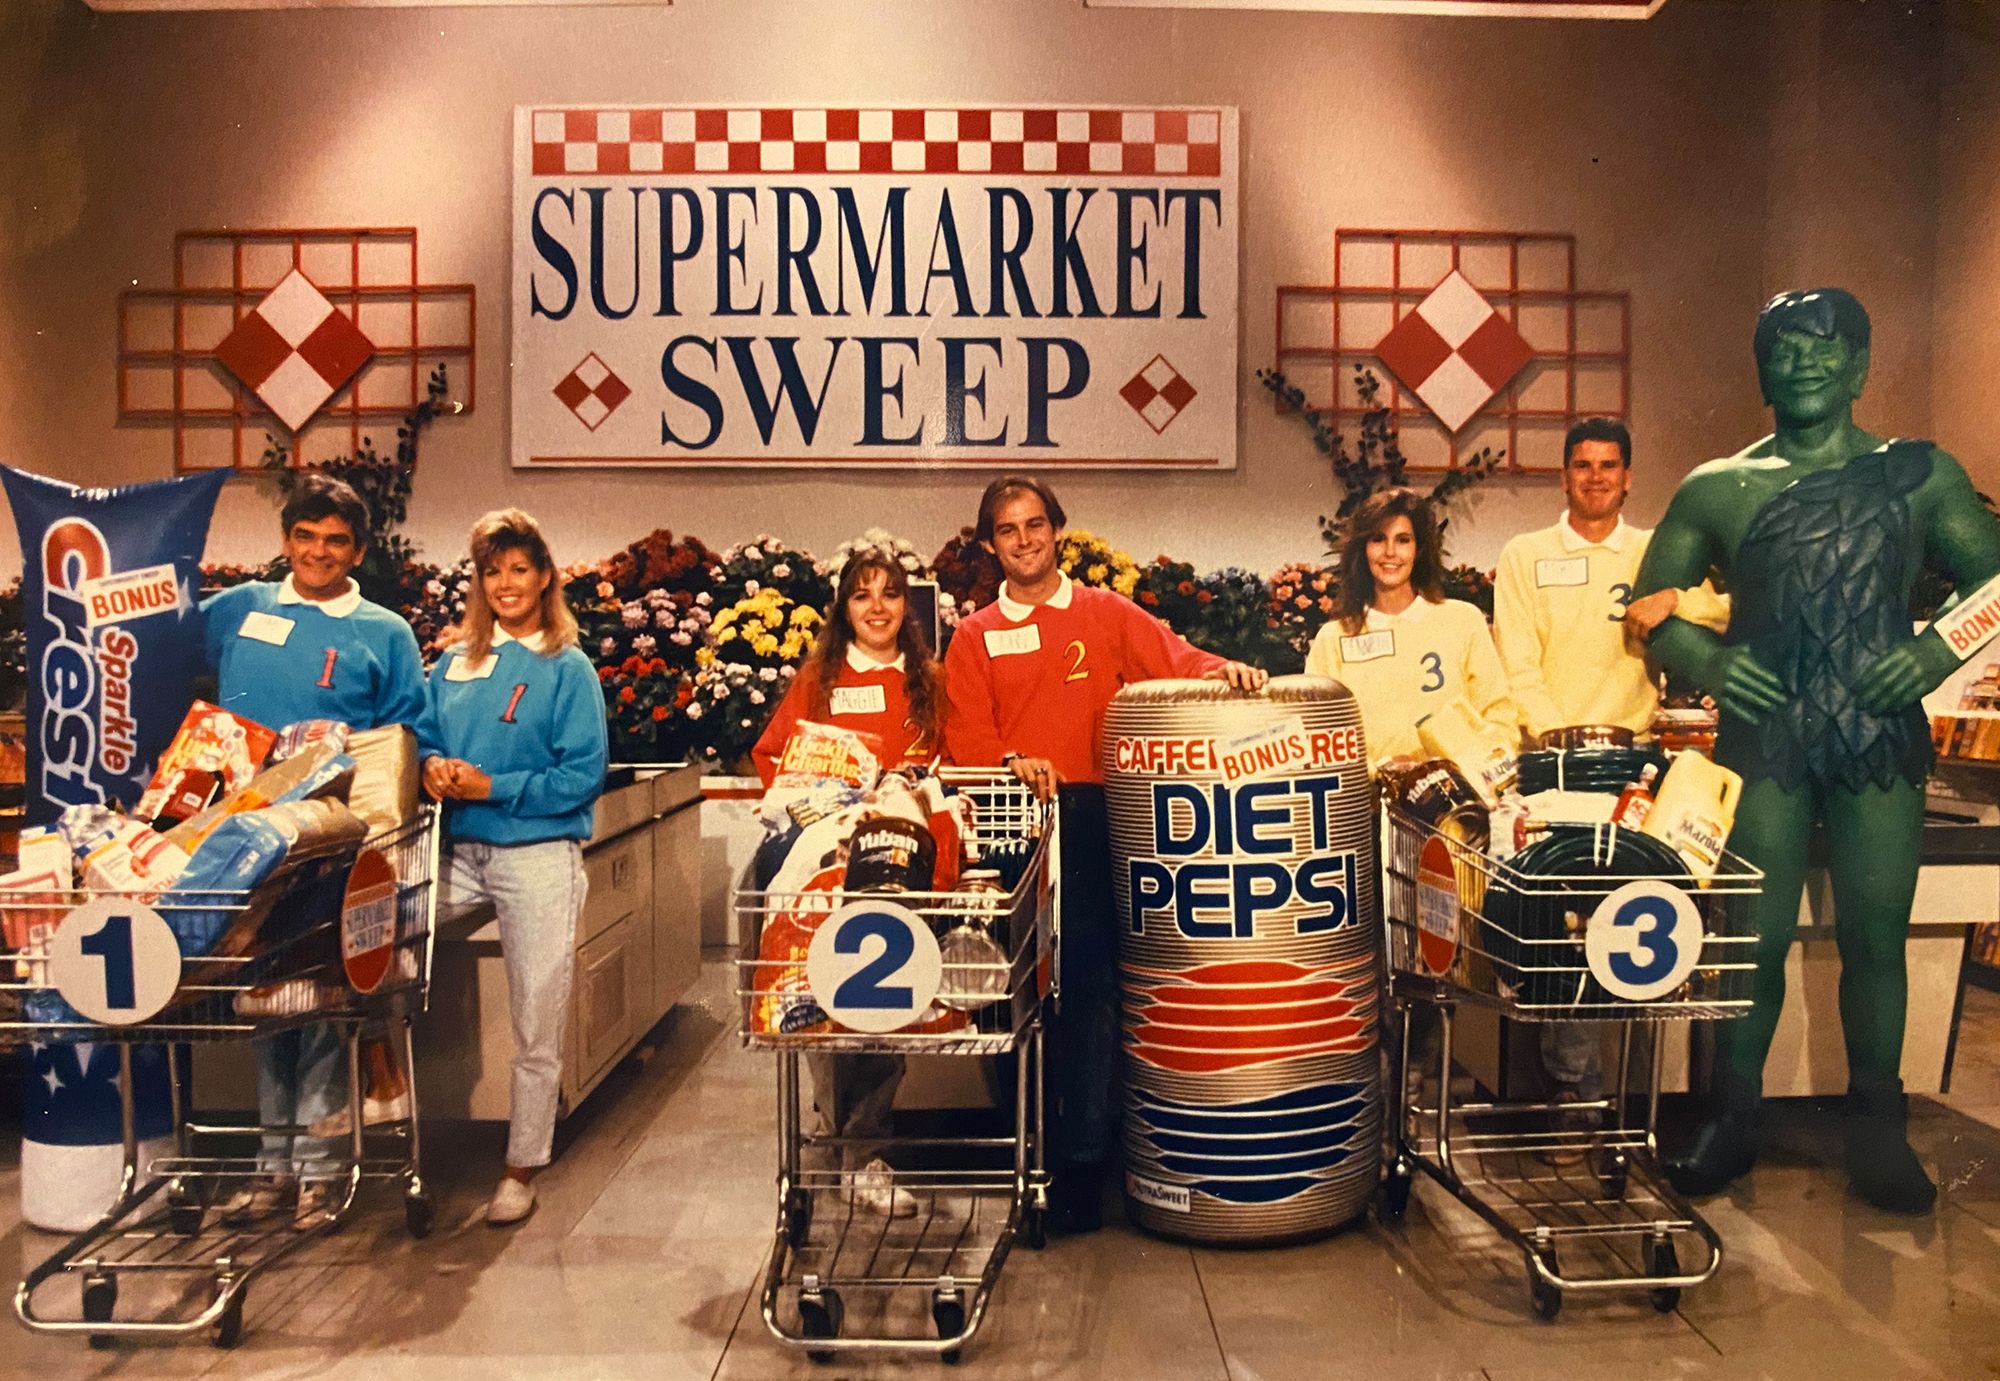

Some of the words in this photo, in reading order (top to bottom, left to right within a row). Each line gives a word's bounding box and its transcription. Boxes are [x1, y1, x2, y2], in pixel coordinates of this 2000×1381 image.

[531, 186, 1222, 321] SUPERMARKET
[660, 334, 1091, 450] SWEEP
[92, 580, 177, 618] BONUS
[1606, 582, 1633, 622] 3
[1948, 596, 2000, 651] BONU
[315, 647, 339, 689] 1
[1064, 640, 1090, 683] 2
[1420, 652, 1445, 692] 3
[96, 626, 138, 776] Sparkle
[499, 683, 529, 723] 1
[903, 718, 929, 755] 2
[1115, 738, 1218, 771] CAFFEI
[1309, 729, 1358, 765] REE
[1222, 735, 1305, 780] BONUS
[1153, 775, 1340, 856] DIET
[858, 830, 919, 854] Yuban
[1129, 853, 1358, 938] PEPSI
[81, 916, 136, 1009] 1
[833, 912, 915, 1009] 2
[1608, 895, 1679, 985] 3
